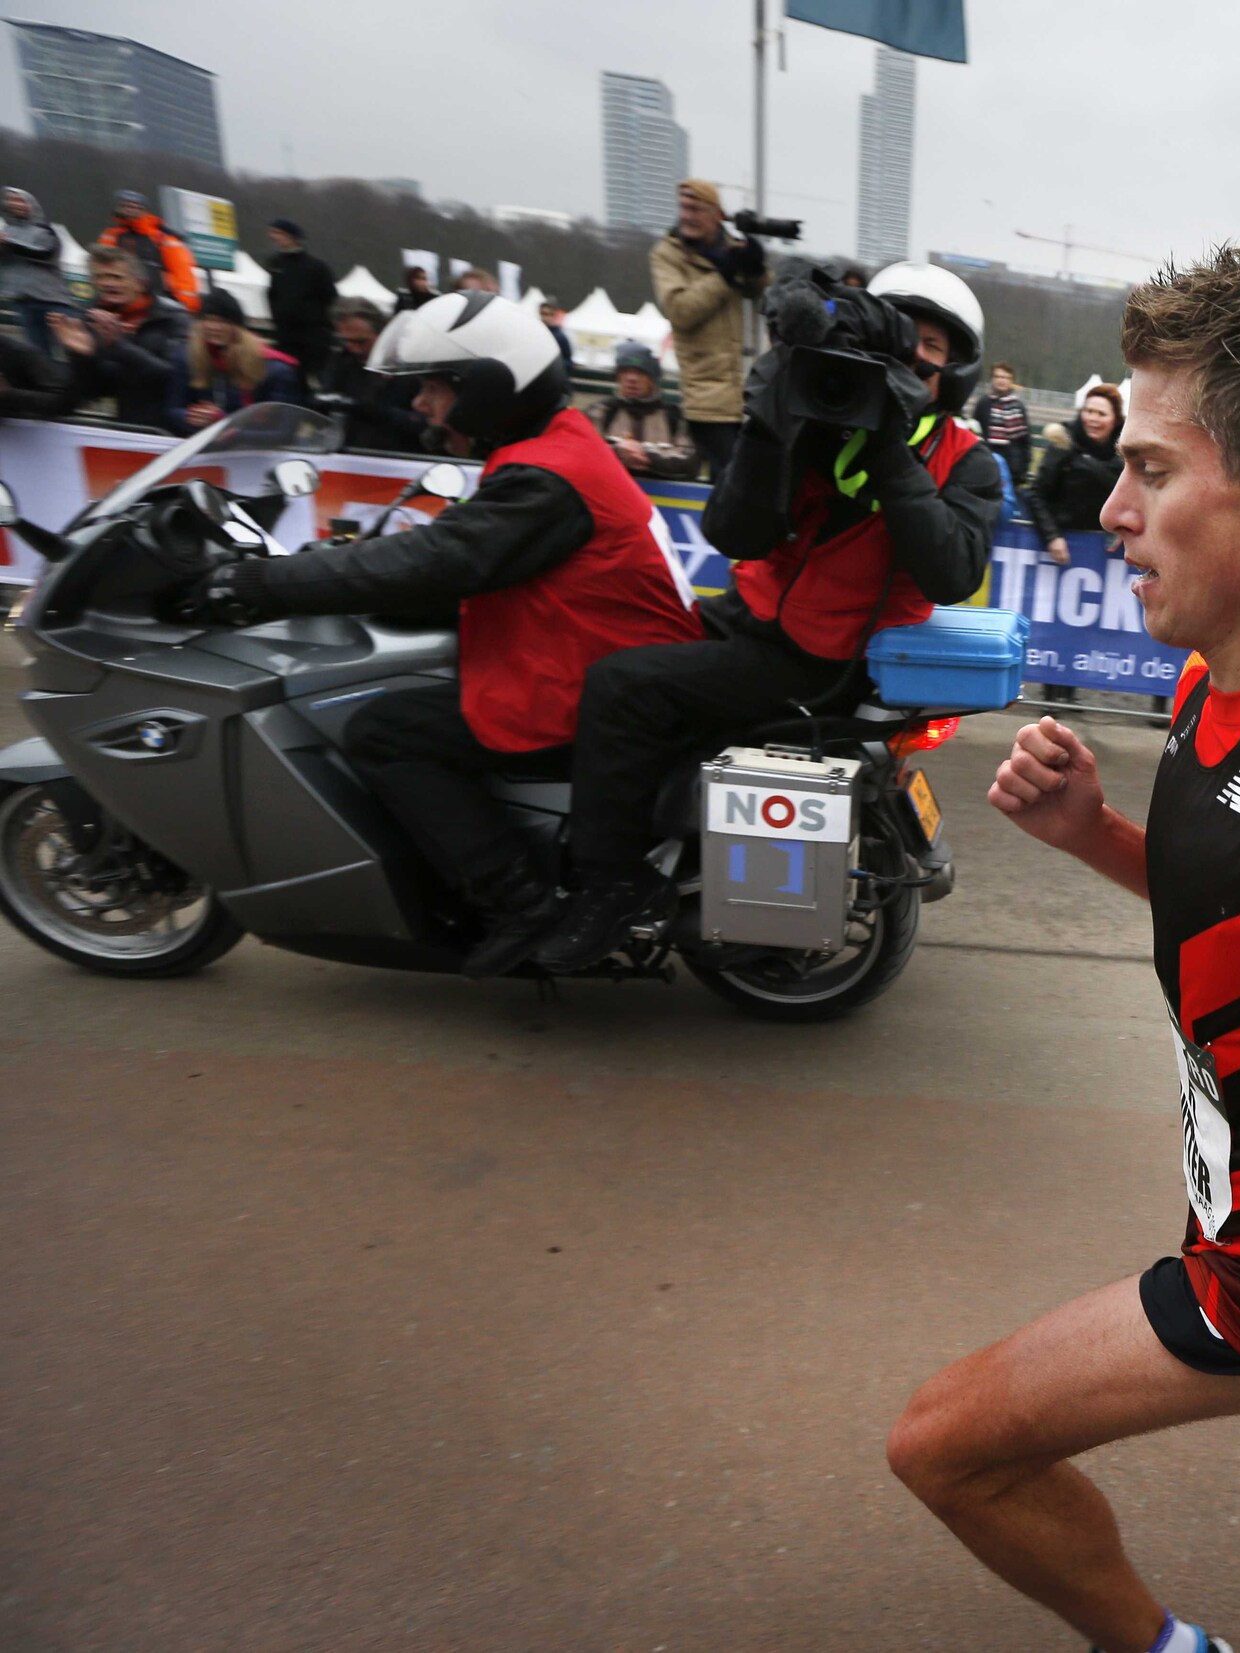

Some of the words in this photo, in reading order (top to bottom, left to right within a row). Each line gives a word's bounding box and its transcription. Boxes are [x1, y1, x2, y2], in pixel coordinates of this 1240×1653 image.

[992, 546, 1143, 633] Tick
[1026, 648, 1066, 672] en,
[1072, 652, 1137, 680] altijd
[1141, 658, 1177, 680] de
[726, 791, 827, 833] NOS
